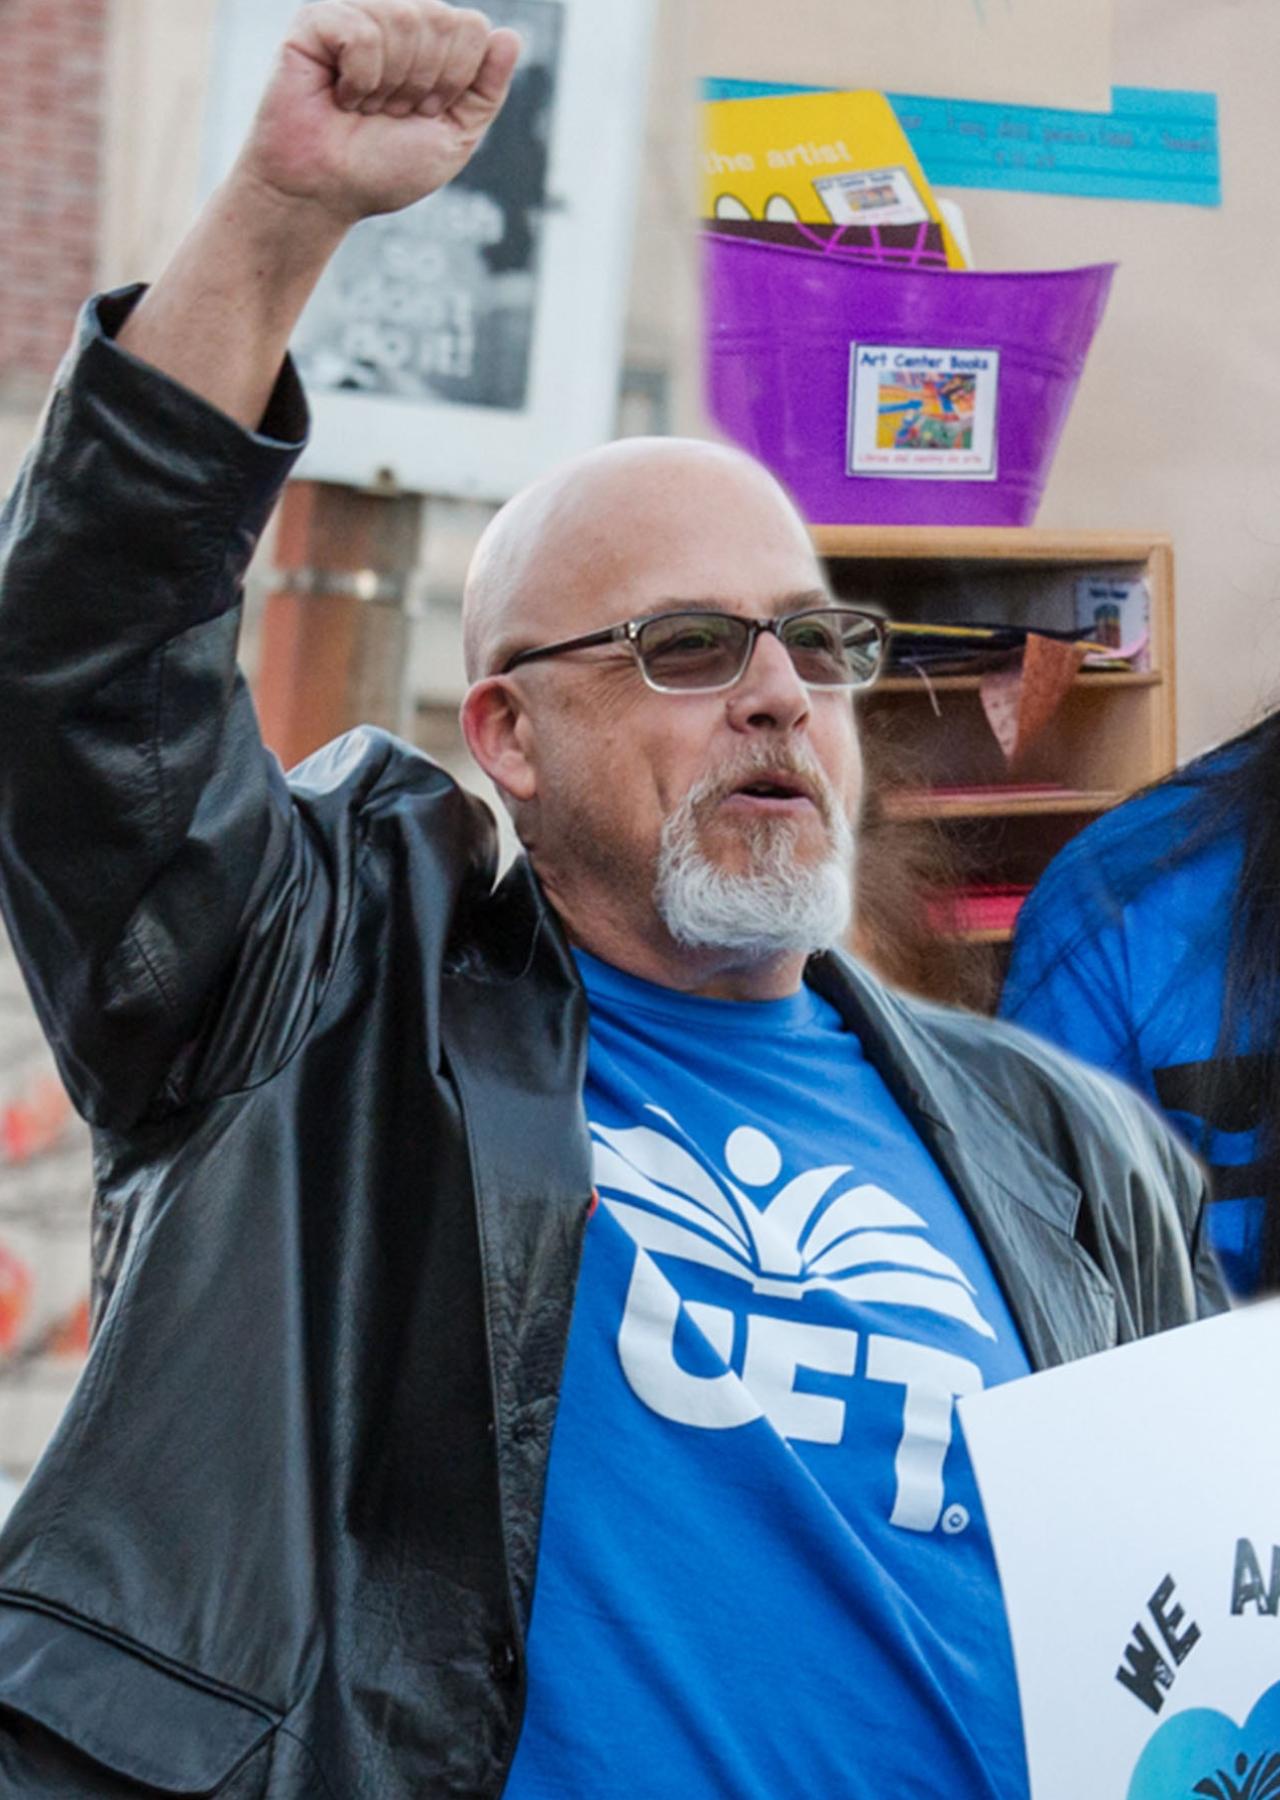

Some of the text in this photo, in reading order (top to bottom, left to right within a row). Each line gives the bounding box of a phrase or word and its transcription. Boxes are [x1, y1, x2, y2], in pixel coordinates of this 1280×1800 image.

[767, 139, 852, 169] artist
[861, 352, 989, 370] Art Center Books
[1115, 1573, 1202, 1715] WE
